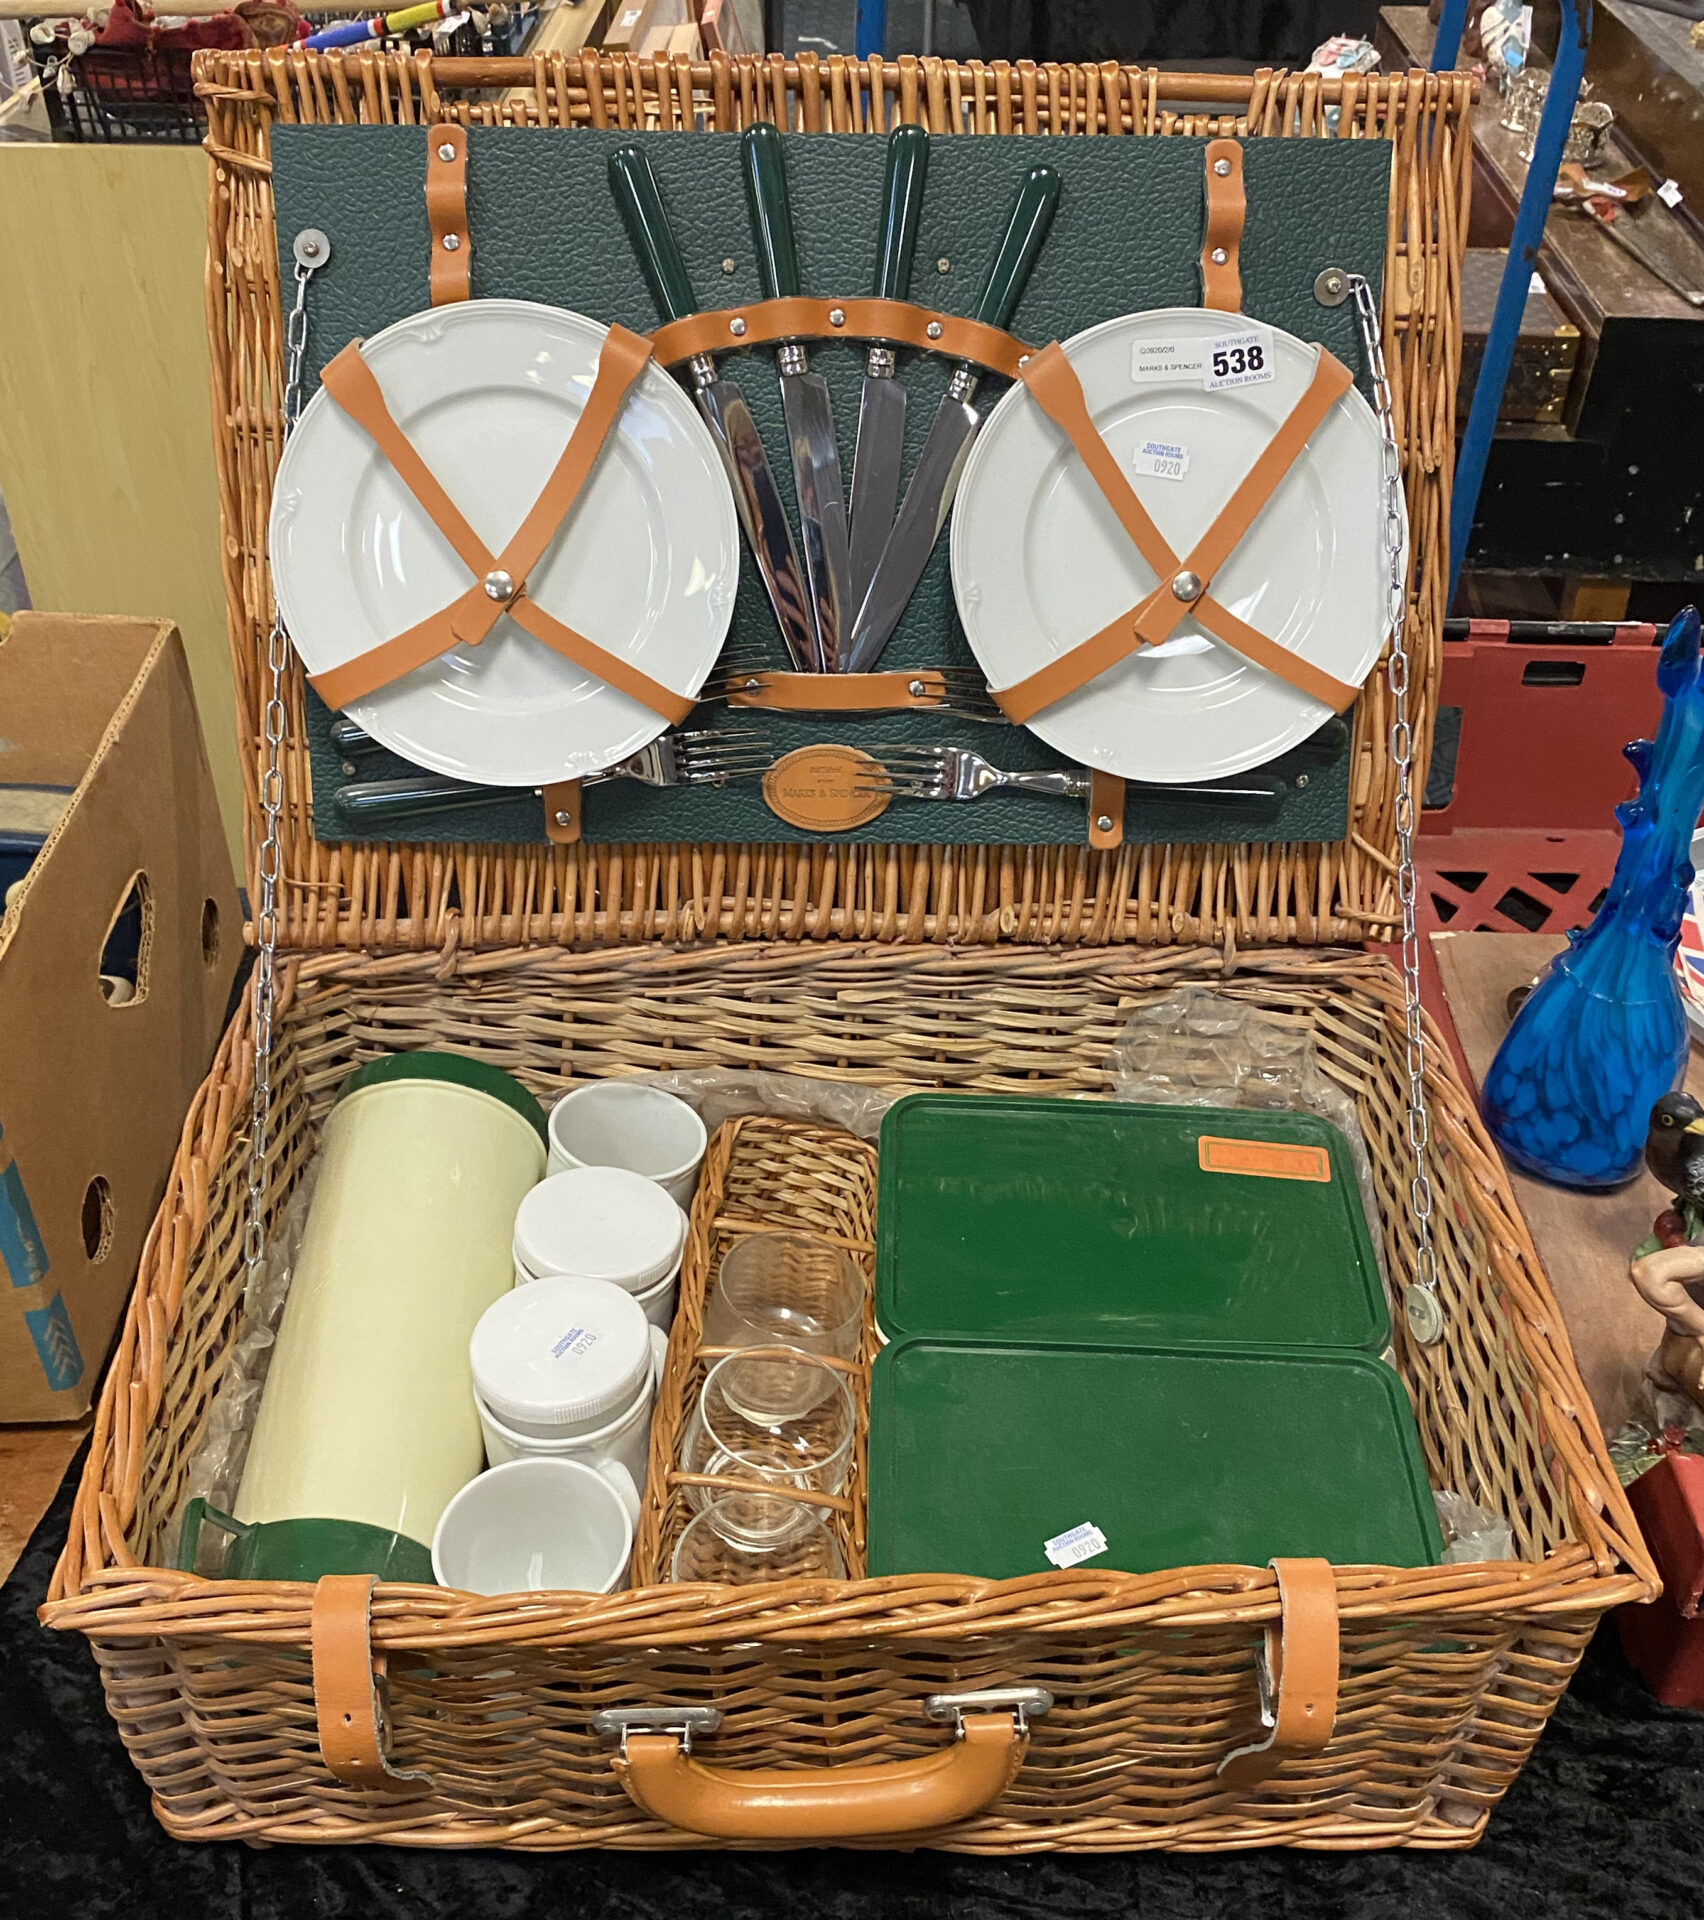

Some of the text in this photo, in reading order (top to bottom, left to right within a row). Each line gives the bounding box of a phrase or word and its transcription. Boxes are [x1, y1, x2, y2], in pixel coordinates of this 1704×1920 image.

[1214, 336, 1260, 348] SOUTHGATE
[1138, 364, 1163, 372] MARKS
[1170, 363, 1202, 371] SPENCER
[1213, 345, 1264, 377] 538
[1209, 371, 1272, 389] AUCTION ROOMS
[1146, 442, 1182, 453] SOUTHGATE
[1154, 459, 1181, 475] 0920
[572, 1333, 597, 1355] 0920
[1052, 1526, 1086, 1545] SOUTHGATE
[1071, 1538, 1101, 1558] 0920
